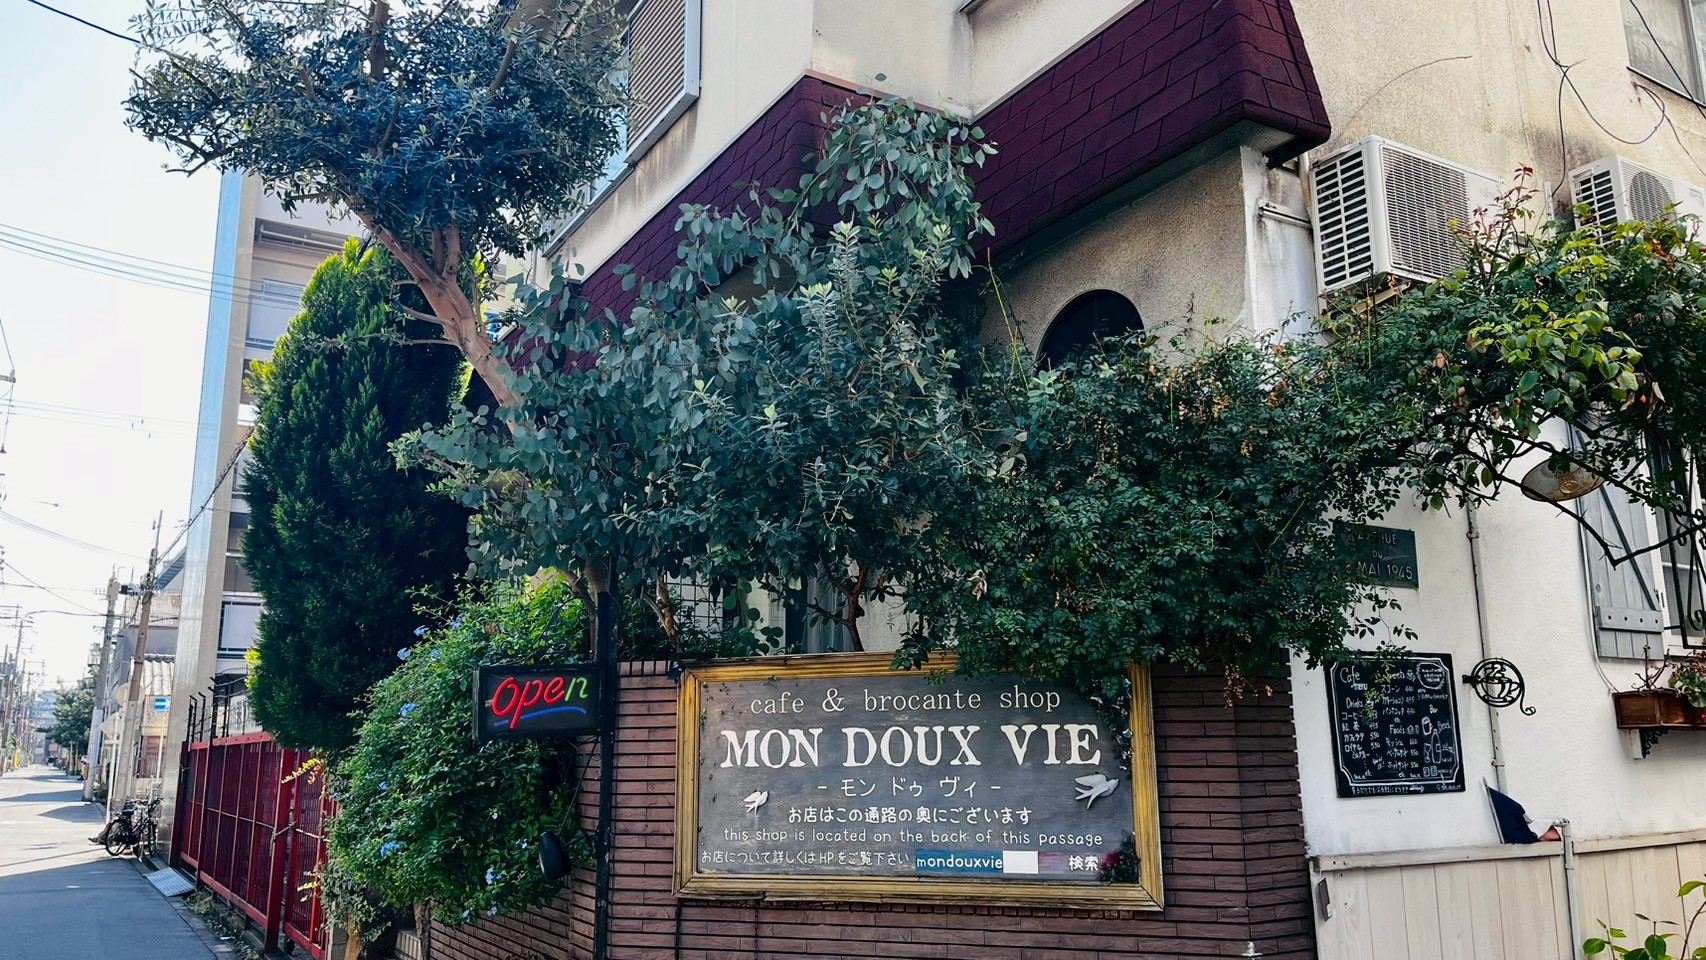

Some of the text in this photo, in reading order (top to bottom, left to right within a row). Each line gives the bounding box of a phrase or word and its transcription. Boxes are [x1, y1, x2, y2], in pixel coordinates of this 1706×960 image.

[1373, 550, 1383, 559] DU
[1357, 561, 1413, 580] MAI 1945
[1340, 665, 1361, 684] Cafe
[491, 676, 589, 731] Open
[750, 685, 1061, 714] cafe & brocante shop
[1346, 697, 1364, 709] Drinks
[720, 724, 1101, 769] MON DOUX VIE
[840, 776, 976, 798] モン ドゥ ヴィ
[788, 806, 1032, 825] お店はこの通路の奥にございます
[724, 828, 1103, 847] this shop is located on the back of this passage
[916, 855, 1003, 870] mondouxvie
[1068, 855, 1099, 871] 検索
